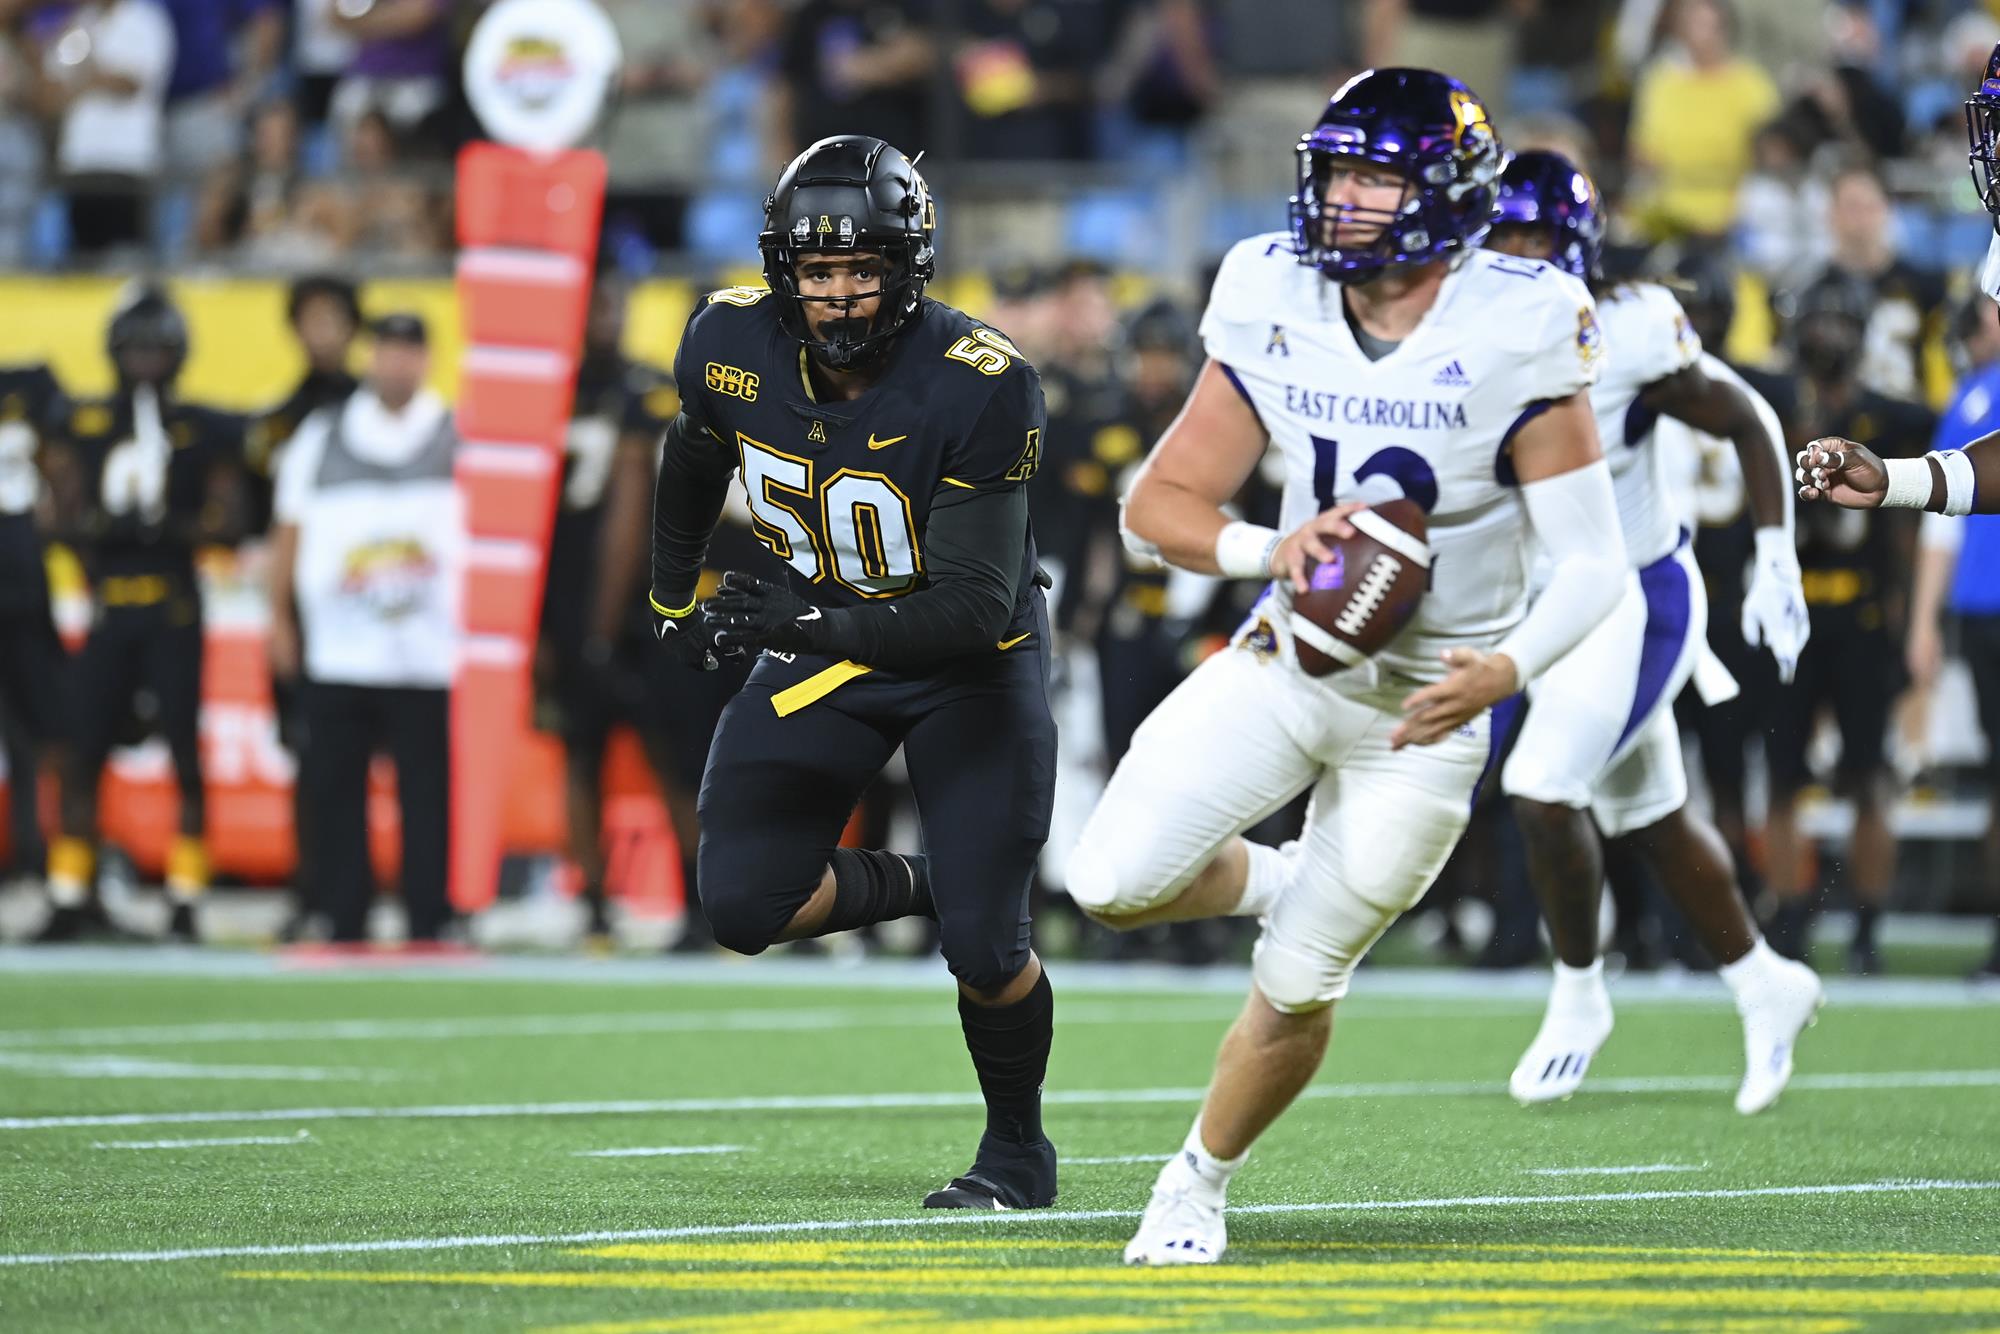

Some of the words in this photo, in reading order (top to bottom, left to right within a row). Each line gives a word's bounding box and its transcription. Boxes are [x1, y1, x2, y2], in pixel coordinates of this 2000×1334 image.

[816, 215, 833, 233] A
[944, 328, 1028, 376] 50
[706, 361, 760, 402] SBC
[1285, 385, 1338, 422] EAST
[1344, 396, 1468, 430] CAROLINA
[807, 420, 827, 443] A
[1004, 427, 1040, 481] A
[735, 431, 924, 599] 50
